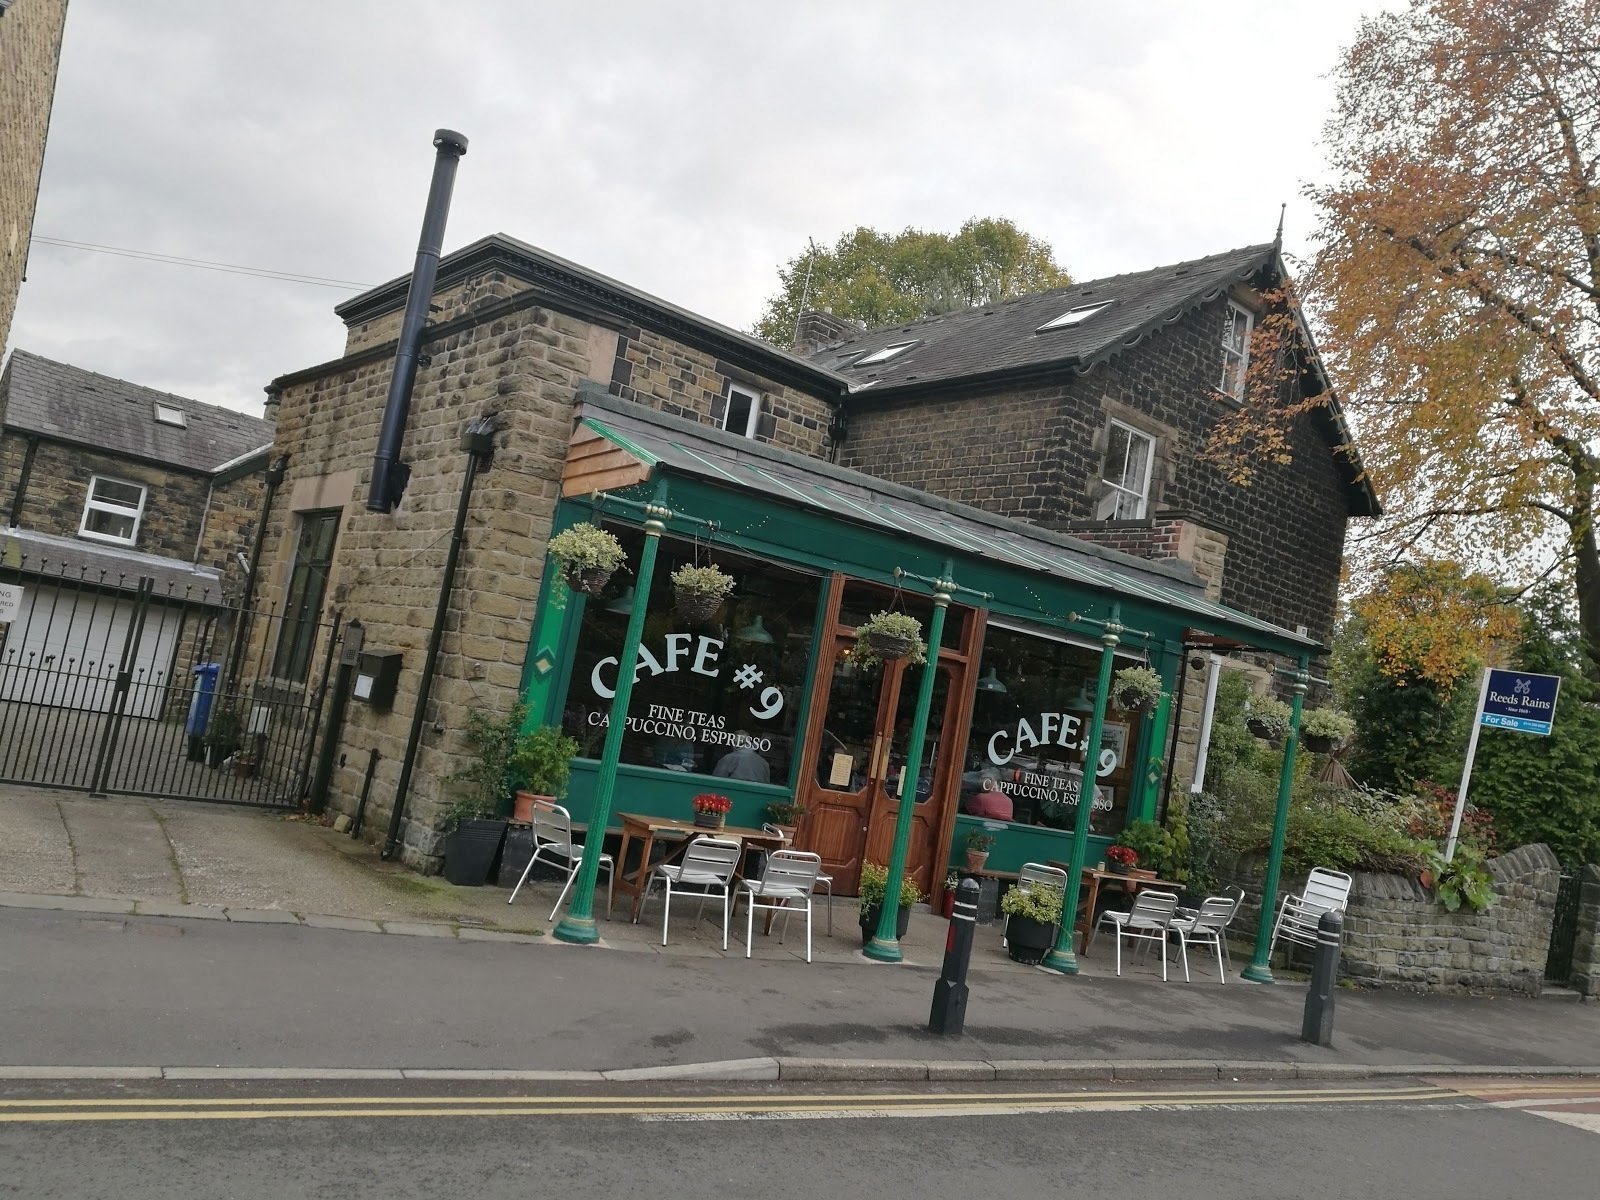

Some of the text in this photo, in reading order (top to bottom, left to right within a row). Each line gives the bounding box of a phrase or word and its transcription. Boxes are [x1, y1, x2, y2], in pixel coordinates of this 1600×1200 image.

[591, 633, 784, 720] CAFE #9
[1489, 691, 1551, 709] Reeds Rains
[648, 704, 726, 729] FINE TEAS
[1485, 715, 1500, 724] For
[1500, 717, 1519, 727] Sale
[588, 712, 772, 752] CAPUCCINO, ESPRESSO
[988, 713, 1082, 766] CAFE
[983, 779, 1113, 811] CAPPUCCINO, ESPSSO
[1024, 772, 1079, 792] FINE TEAS
